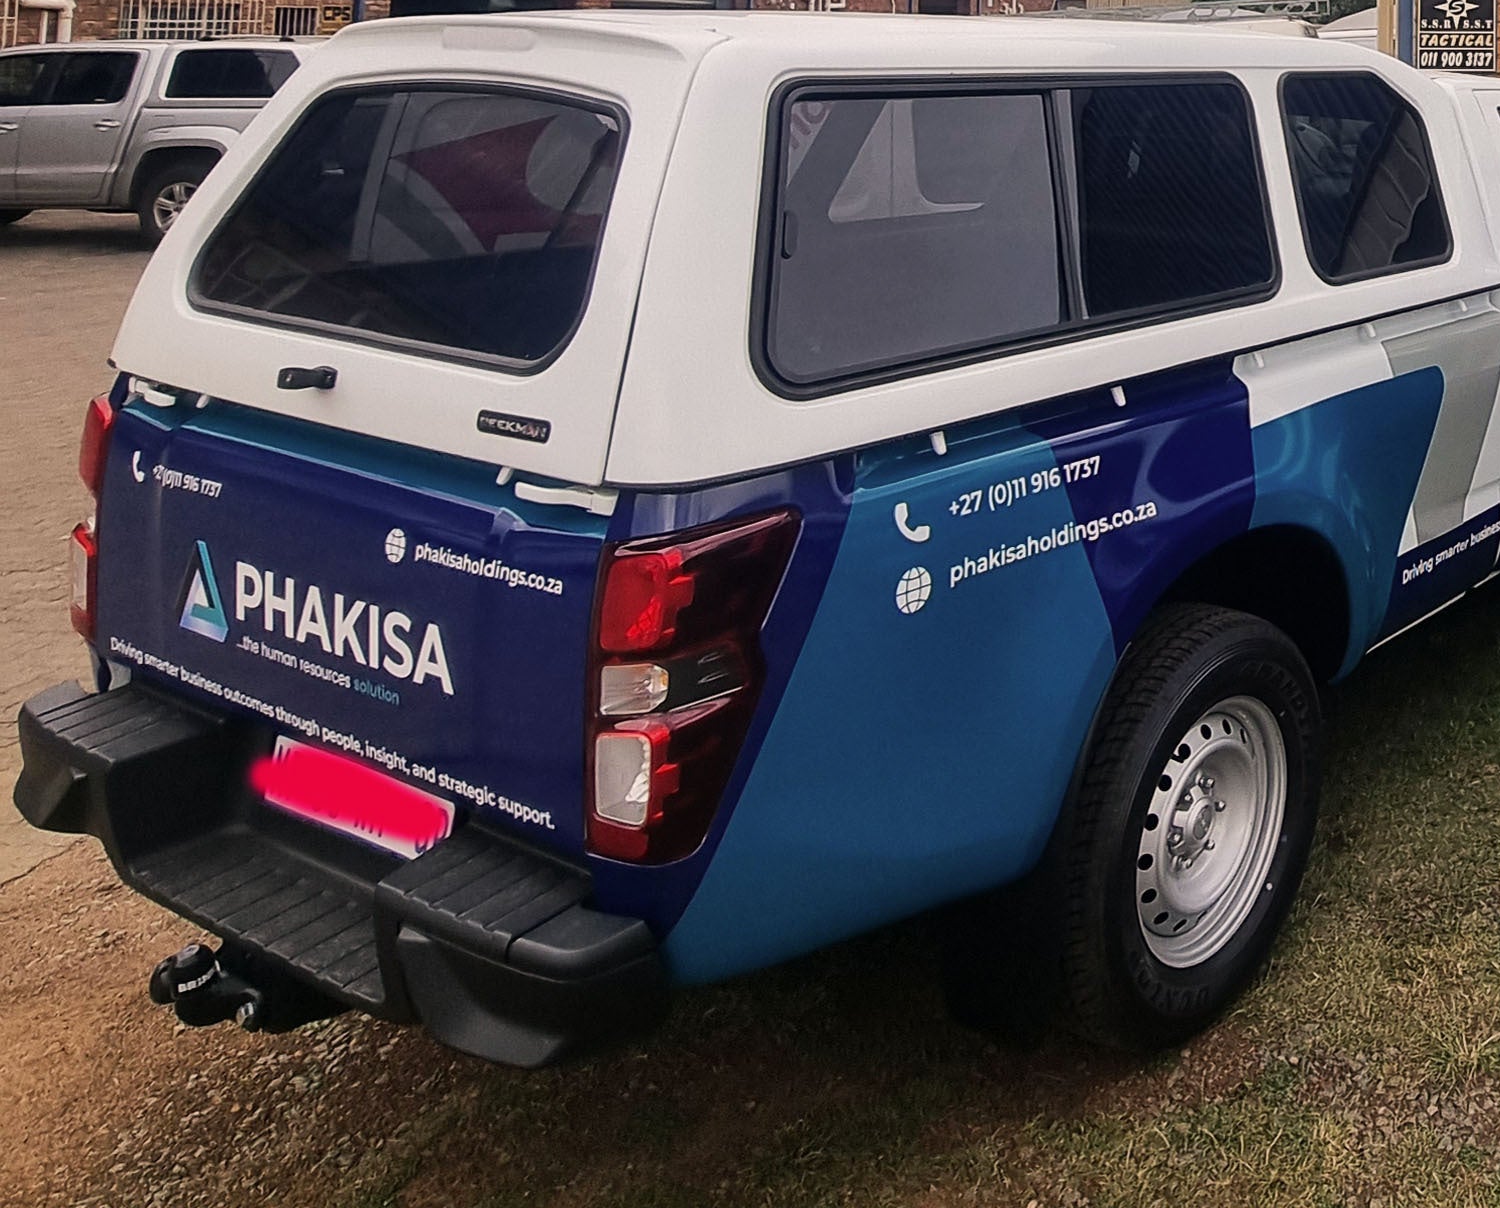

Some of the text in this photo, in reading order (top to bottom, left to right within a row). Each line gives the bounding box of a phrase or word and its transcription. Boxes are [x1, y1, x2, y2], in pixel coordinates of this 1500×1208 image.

[1420, 34, 1494, 47] TACTICAL
[1420, 51, 1494, 68] 011 900 3137
[182, 474, 201, 492] 916
[200, 478, 223, 498] 1737
[949, 455, 1101, 517] +27 (0)11 916 1737
[414, 542, 563, 595] phakisaholdings.co.za
[949, 501, 1158, 588] phakisaholdings.co.za
[1402, 557, 1434, 585] Driving
[235, 560, 455, 696] PHAKISA
[261, 643, 298, 670] human
[299, 658, 351, 689] resources
[353, 678, 400, 705] solution
[110, 636, 556, 831] Driving smarter business outcomes through people, insight, and strategic support.
